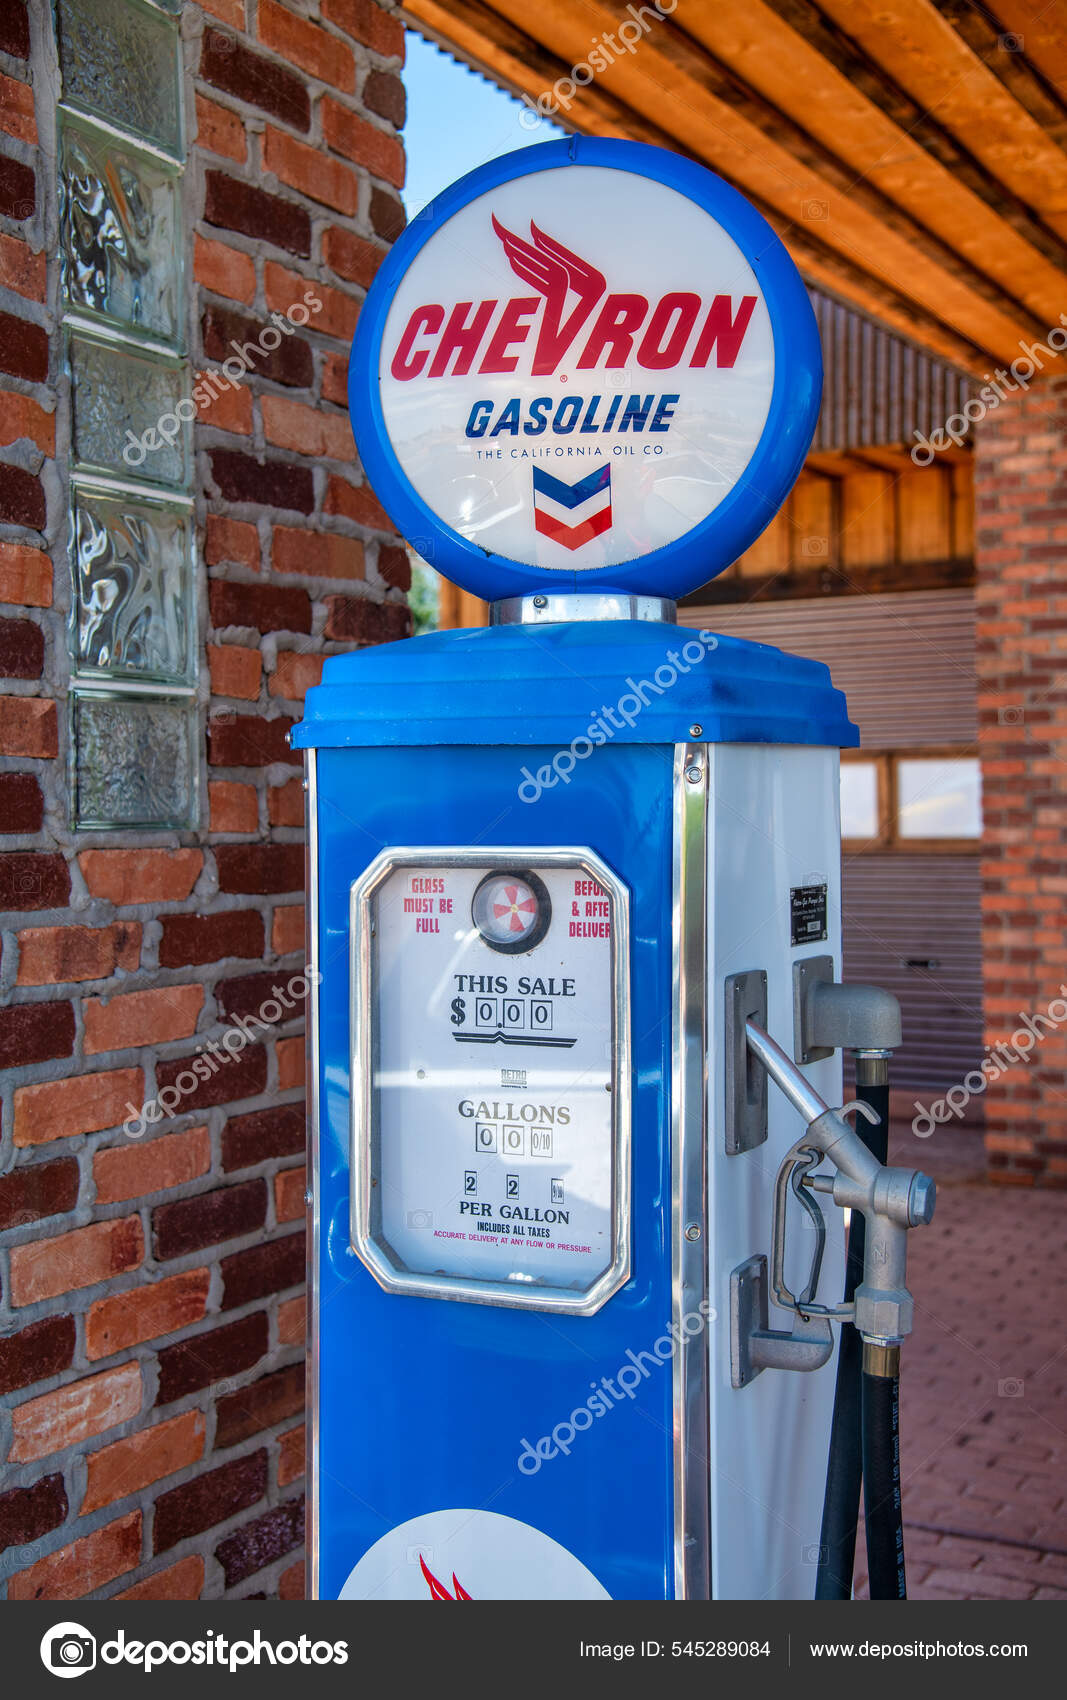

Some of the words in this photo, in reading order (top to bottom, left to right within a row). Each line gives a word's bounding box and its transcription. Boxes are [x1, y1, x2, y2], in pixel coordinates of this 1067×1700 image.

[391, 268, 758, 381] CHEVRON
[465, 394, 680, 438] GASOLINE
[477, 450, 502, 460] THE
[511, 447, 602, 458] CALIFORNIA
[613, 445, 635, 456] OIL
[643, 445, 669, 455] CO.
[411, 878, 445, 894] GLASS
[404, 898, 435, 913] MUST
[439, 899, 453, 914] BE
[571, 901, 580, 917] &
[416, 918, 440, 933] FULL
[454, 974, 508, 994] THIS
[518, 976, 576, 996] SALE
[458, 1100, 571, 1125] GALLONS
[460, 1201, 493, 1216] PER
[500, 1205, 570, 1224] GALLON
[477, 1221, 511, 1234] INCLUDES
[513, 1225, 525, 1235] ALL
[528, 1226, 550, 1239] TAXES
[434, 1230, 467, 1240] ACCURATE
[468, 1233, 498, 1244] DELIVERY
[510, 1238, 524, 1246] ANY
[526, 1239, 543, 1248] FLOW
[557, 1243, 592, 1254] PRESSURE
